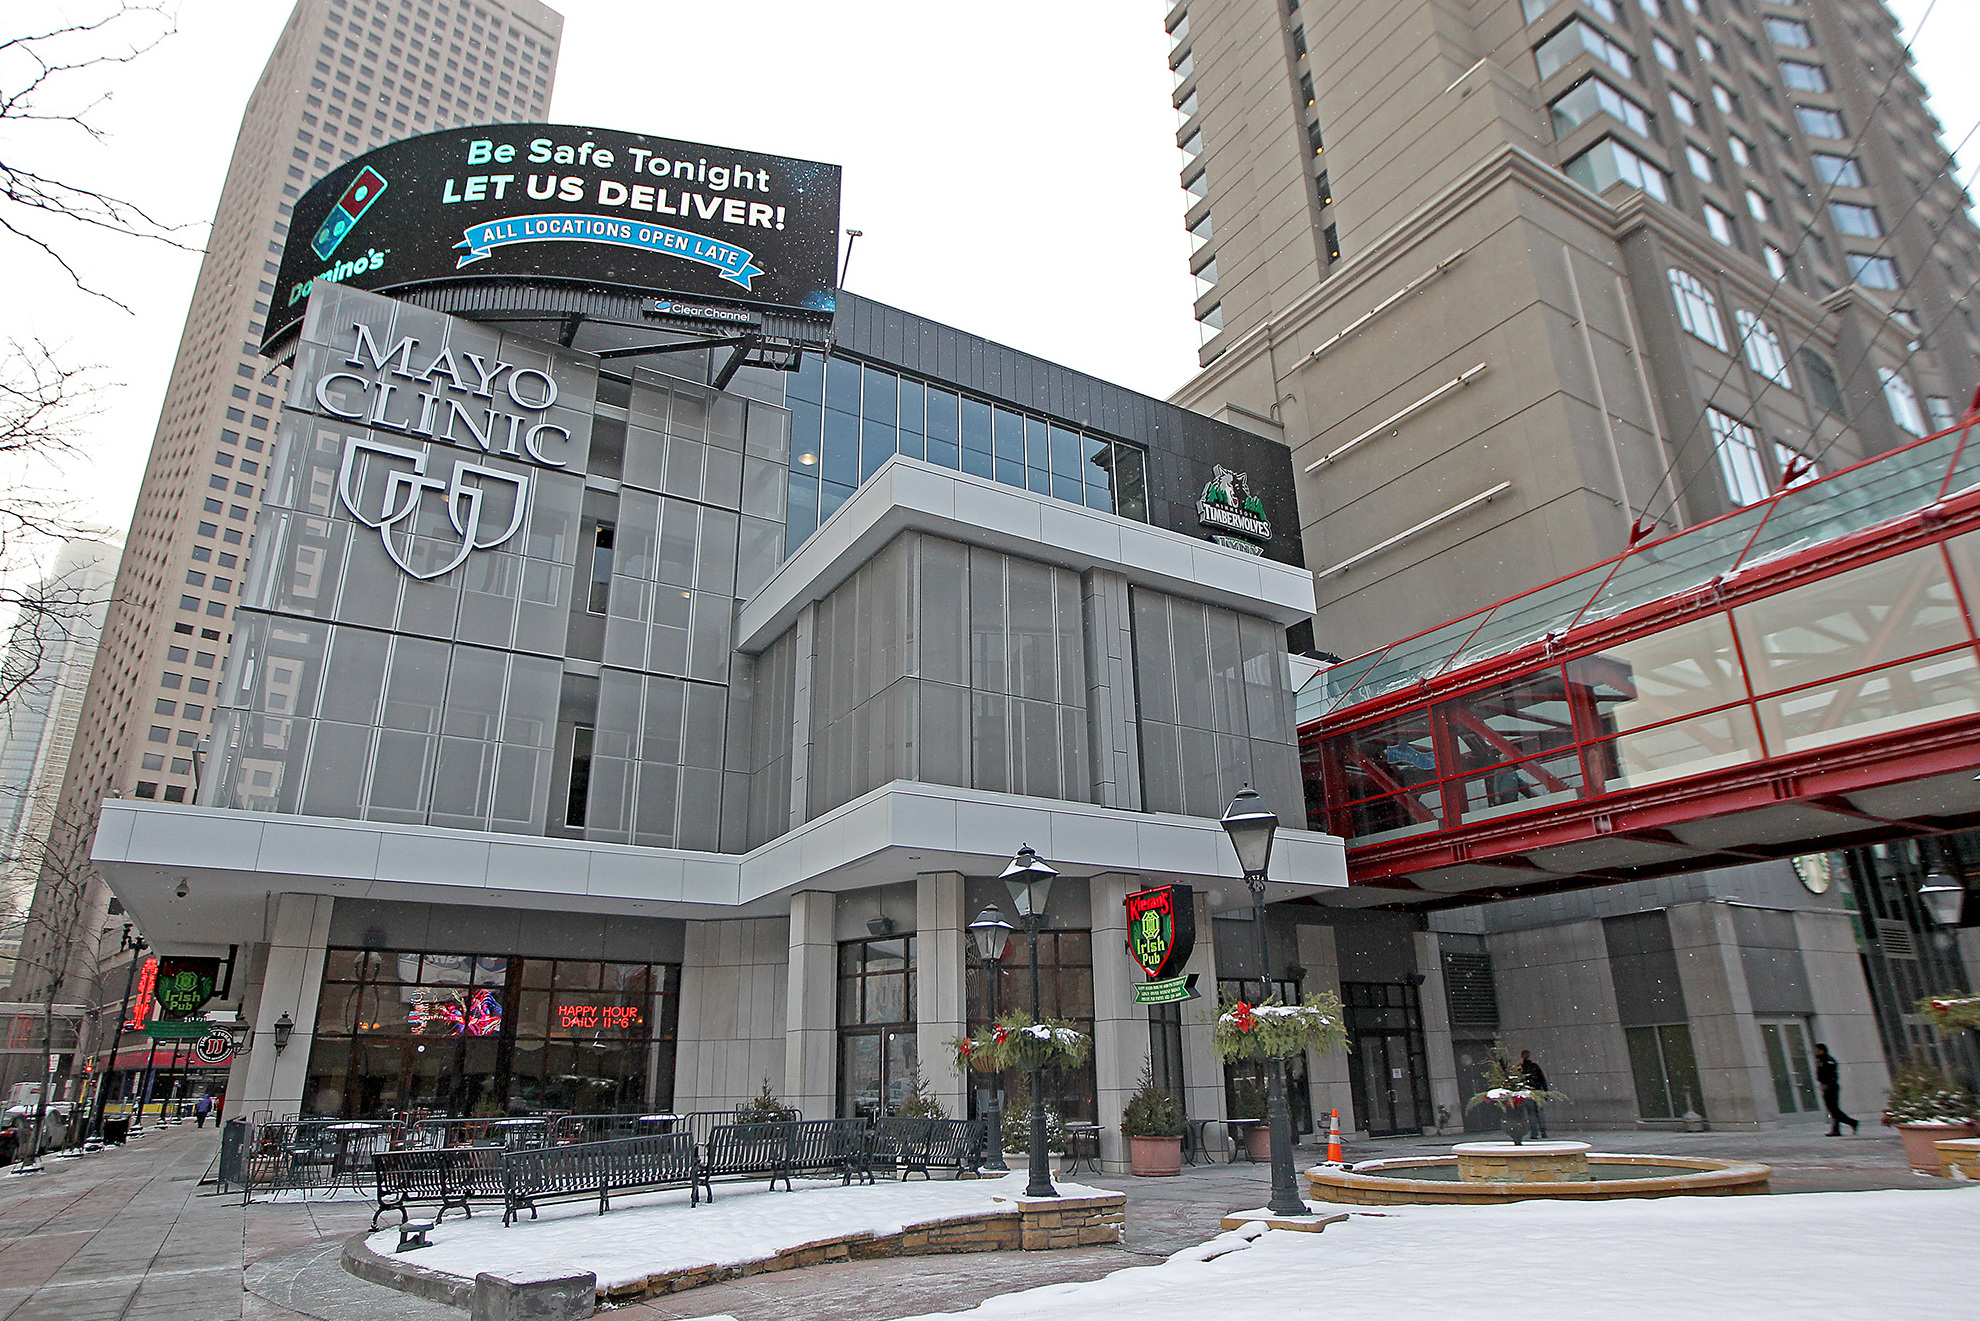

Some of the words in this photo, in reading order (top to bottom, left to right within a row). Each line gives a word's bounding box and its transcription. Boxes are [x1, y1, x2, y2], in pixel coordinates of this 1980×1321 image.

[467, 139, 516, 165] Be
[527, 137, 615, 168] Safe
[628, 147, 770, 193] Tonight
[442, 174, 515, 204] LET
[526, 174, 584, 202] US
[597, 179, 786, 231] DELIVER!
[483, 222, 518, 243] ALL
[524, 219, 632, 239] LOCATIONS
[638, 227, 689, 251] OPEN
[694, 240, 740, 267] LATE
[672, 303, 702, 316] Clear
[704, 307, 750, 321] Channel
[345, 322, 559, 410] MAYO
[315, 372, 572, 467] CLINIC
[1202, 502, 1270, 537] TIMBERWOLVES
[1215, 502, 1258, 519] MINNESOTA
[1137, 935, 1166, 955] Irish
[1142, 952, 1160, 966] Pub
[165, 989, 201, 1002] Irish
[169, 1001, 193, 1011] Pub
[558, 1005, 598, 1017] HAPPY
[602, 1006, 639, 1018] HOUR
[561, 1016, 599, 1028] DAILY
[206, 1038, 225, 1054] JJ
